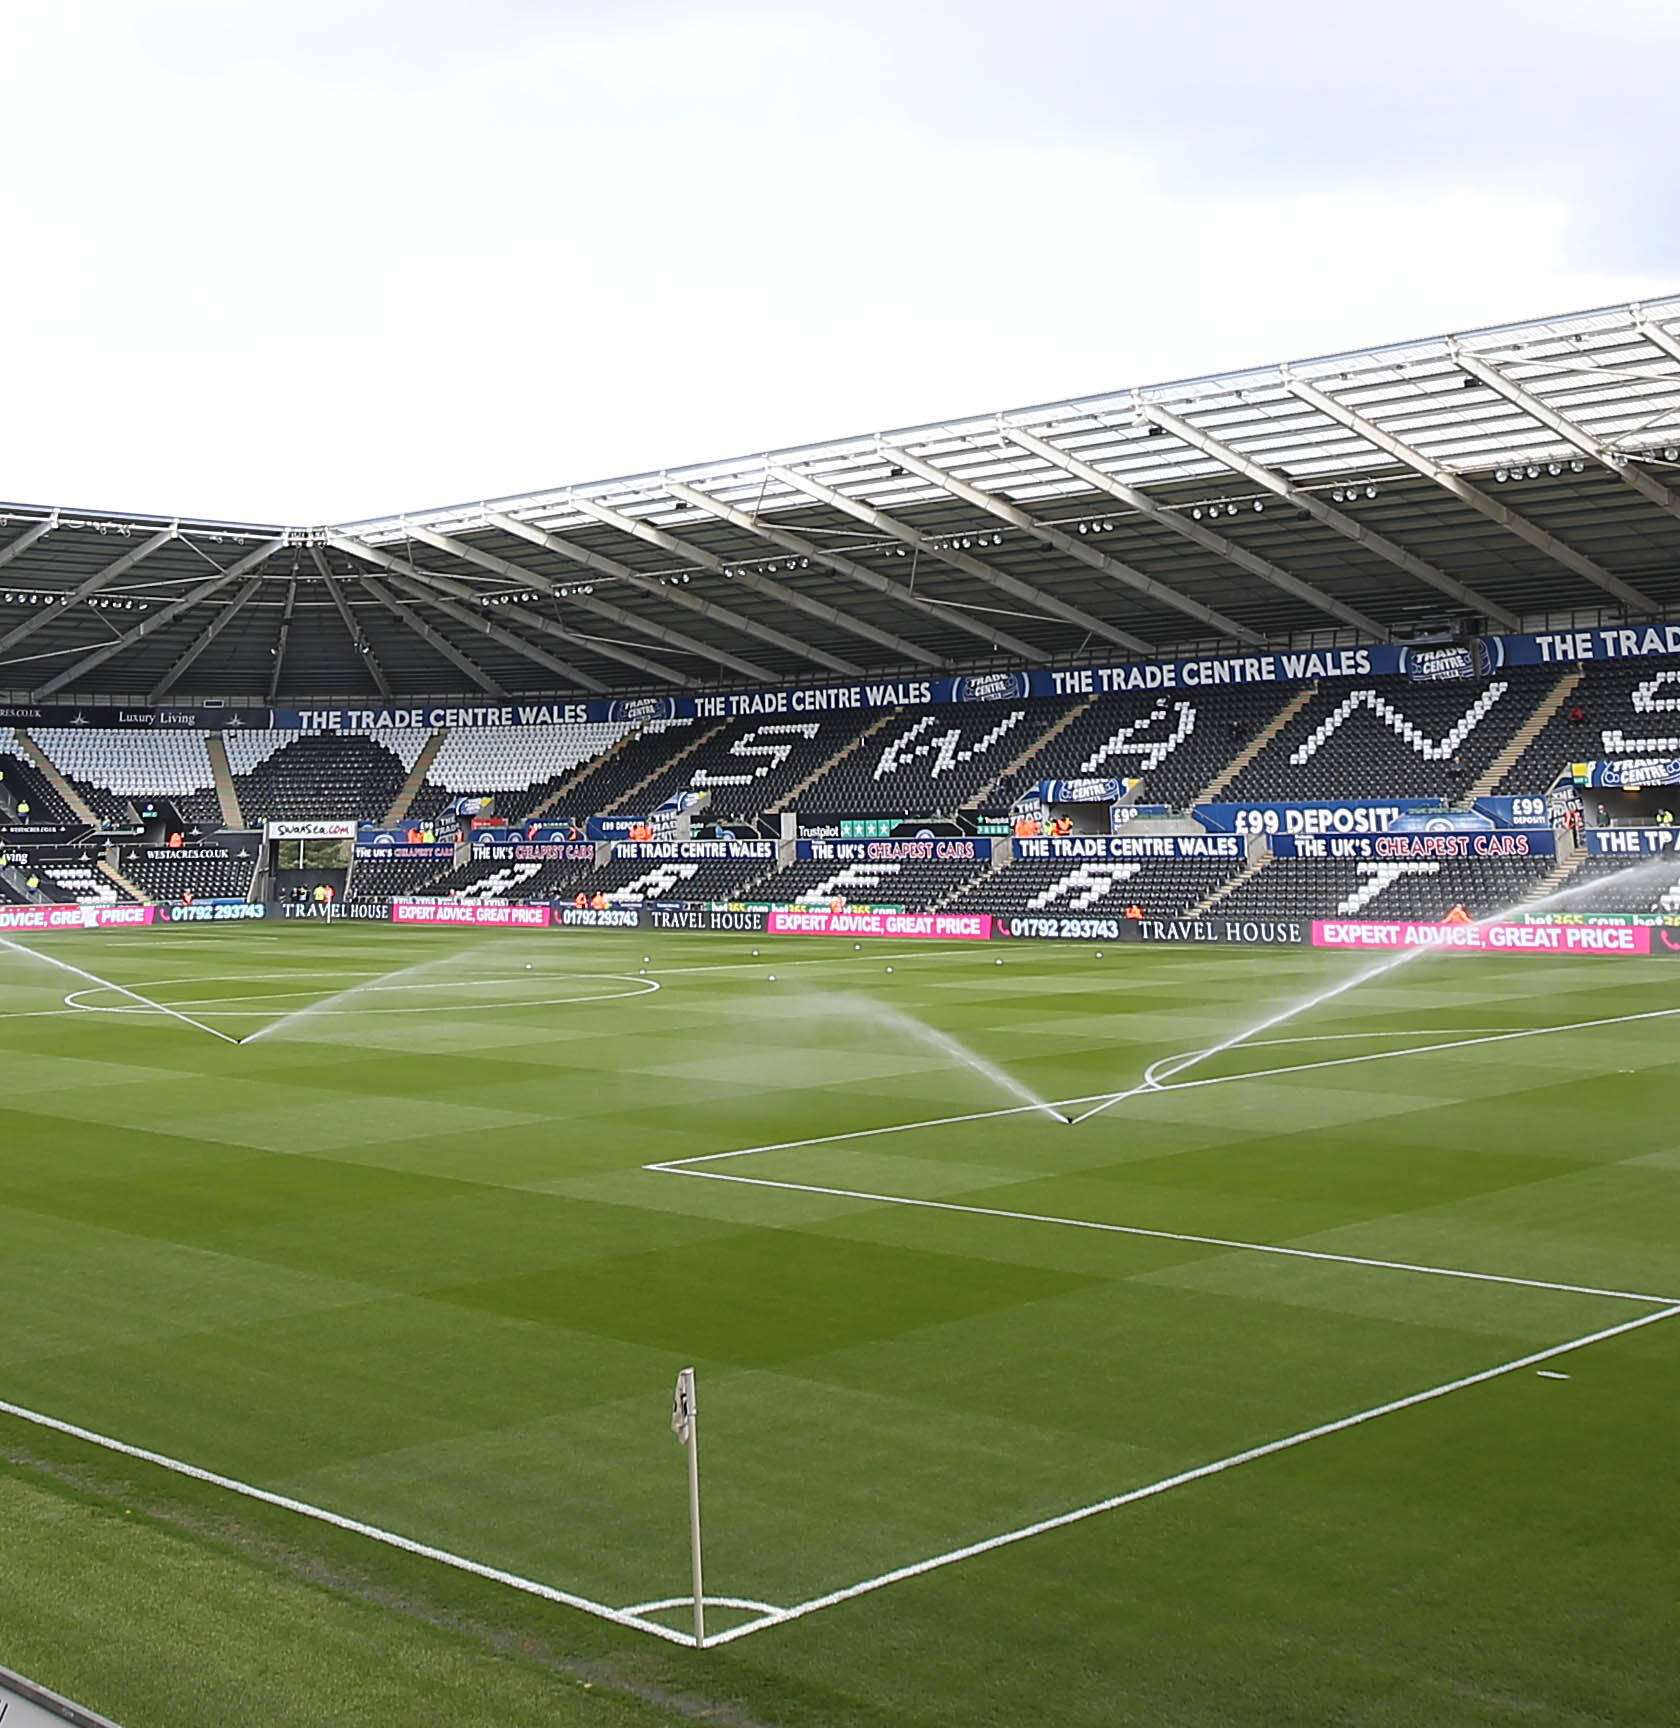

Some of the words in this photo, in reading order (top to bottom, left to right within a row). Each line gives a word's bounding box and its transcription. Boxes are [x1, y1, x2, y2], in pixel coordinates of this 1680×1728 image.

[1536, 633, 1593, 662] THE
[1052, 671, 1093, 695] THE
[1098, 664, 1176, 691] TRADE
[1182, 657, 1275, 686] CENTRE
[1283, 649, 1371, 677] WALES
[694, 697, 726, 718] THE
[730, 692, 787, 716] TRADE
[791, 687, 860, 713] CENTRE
[865, 682, 932, 707] WALES
[119, 710, 156, 726] Luxury
[160, 711, 195, 726] Living
[298, 710, 341, 729] THE
[348, 709, 424, 728] TRADE
[429, 707, 513, 727] CENTRE
[517, 704, 588, 725] WALES
[1512, 798, 1544, 815] £99
[1234, 811, 1278, 834] £99
[1285, 808, 1399, 833] DEPOSIT!
[799, 825, 839, 839] Trustpilot
[811, 844, 835, 860] THE
[838, 844, 865, 859] UK'S
[867, 842, 934, 859] CHEAPEST
[936, 841, 975, 858] CARS
[1019, 839, 1050, 857] THE
[1052, 838, 1106, 857] TRADE
[1110, 837, 1175, 856] CENTRE
[1177, 836, 1238, 856] WALES
[1294, 838, 1327, 857] THE
[1331, 838, 1371, 856] UK'S
[1375, 836, 1470, 856] CHEAPEST
[1473, 835, 1529, 856] CARS
[171, 905, 213, 921] 01792
[215, 903, 264, 920] 293743
[282, 902, 348, 918] TRAVEL
[350, 903, 388, 919] HOUSE
[398, 906, 435, 919] EXPERT
[437, 906, 476, 922] ADVICE,
[477, 907, 510, 921] GREAT
[512, 908, 543, 923] PRICE
[563, 910, 596, 926] 01792
[598, 910, 638, 927] 293743
[652, 911, 707, 929] TRAVEL
[710, 912, 762, 930] HOUSE
[776, 914, 827, 932] EXPERT
[829, 915, 885, 935] ADVICE,
[887, 916, 934, 935] GREAT
[936, 918, 981, 936] PRICE
[1010, 918, 1059, 937] 01792
[1061, 918, 1119, 939] 293743
[1139, 920, 1217, 941] TRAVEL
[1226, 921, 1302, 943] HOUSE
[1324, 924, 1398, 944] EXPERT
[1405, 925, 1486, 949] ADVICE,
[1488, 927, 1562, 948] GREAT
[1565, 928, 1635, 949] PRICE
